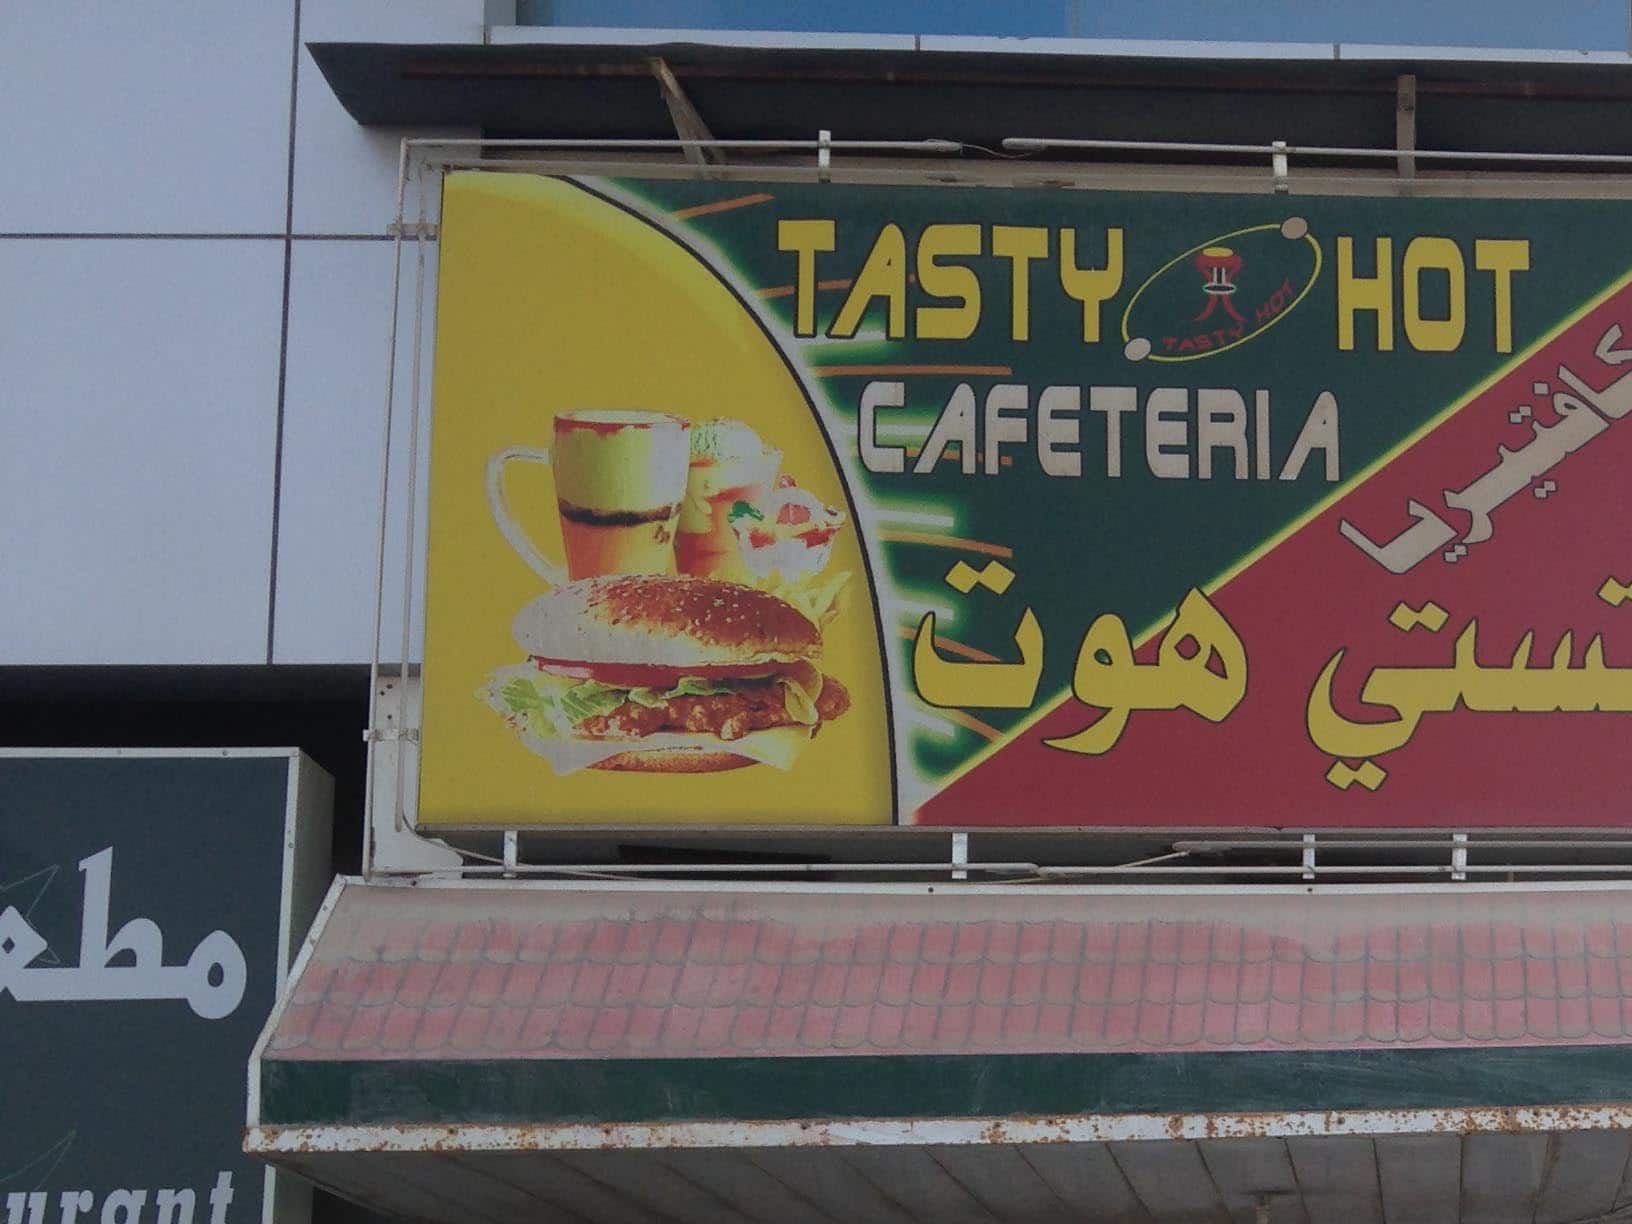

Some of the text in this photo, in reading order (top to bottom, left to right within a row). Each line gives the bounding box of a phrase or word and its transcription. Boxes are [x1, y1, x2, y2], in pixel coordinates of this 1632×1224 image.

[777, 219, 1531, 353] TASTY HOT
[1162, 277, 1294, 350] TASTY HOT
[858, 379, 1340, 482] CAFETERIA
[912, 559, 1250, 757] هوت
